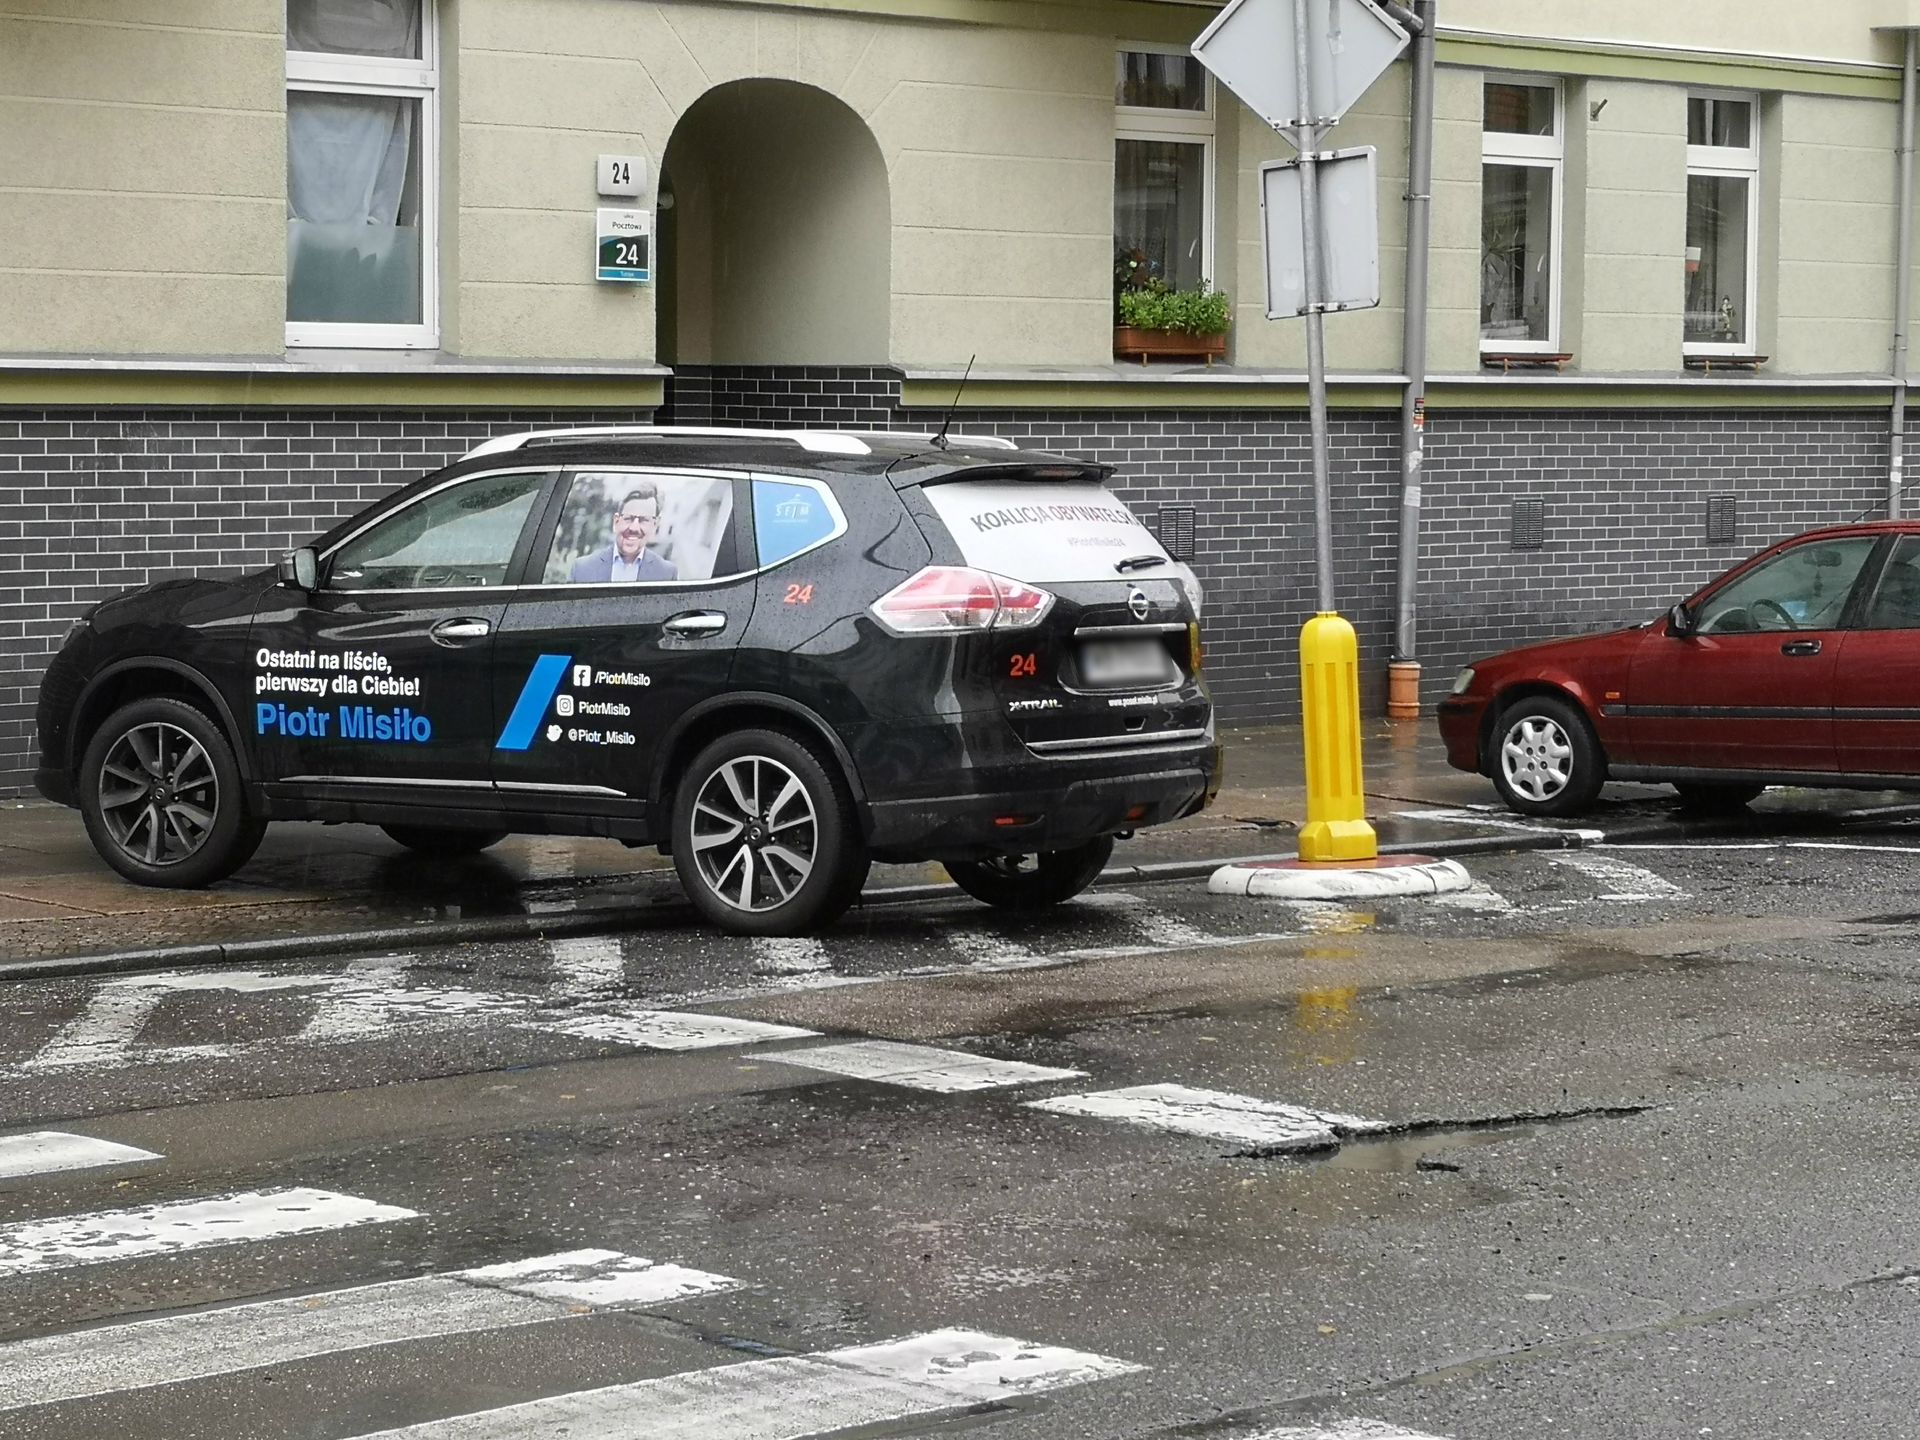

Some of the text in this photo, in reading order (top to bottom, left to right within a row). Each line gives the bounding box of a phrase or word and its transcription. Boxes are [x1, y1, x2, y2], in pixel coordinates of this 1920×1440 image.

[612, 162, 630, 184] 24
[612, 221, 642, 231] Pocztowa
[615, 242, 639, 265] 24
[970, 505, 1051, 532] KOALICJA
[783, 583, 814, 604] 24
[256, 648, 393, 675] Ostatni na liście,
[1010, 653, 1037, 676] 24
[255, 671, 421, 698] pierwszy dla Ciebie!
[1008, 698, 1063, 712] X-TRAIL
[256, 702, 432, 742] Piotr Misiło
[567, 728, 636, 745] @Piotr_Misilo
